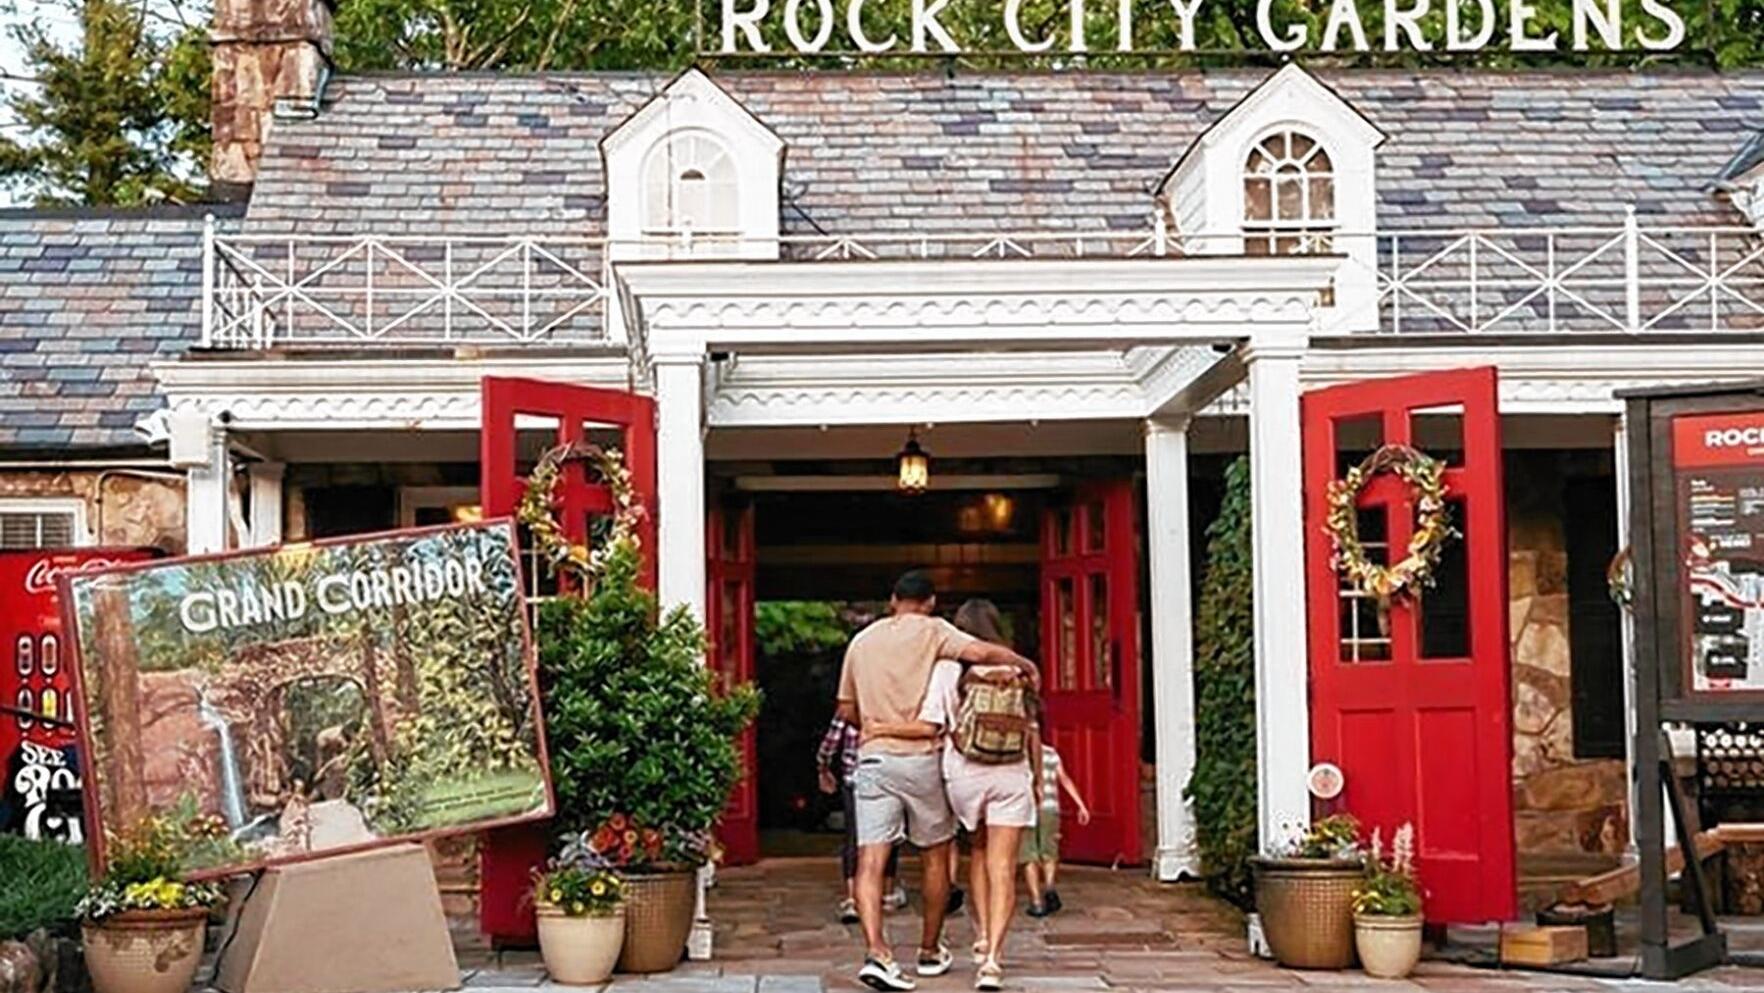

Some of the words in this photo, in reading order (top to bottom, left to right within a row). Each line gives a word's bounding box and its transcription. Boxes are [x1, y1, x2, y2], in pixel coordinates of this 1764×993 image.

[720, 0, 960, 53] ROCK
[1256, 0, 1687, 52] GARDENS
[1705, 427, 1764, 447] ROC
[180, 580, 305, 632] GRAND
[317, 558, 486, 614] CORRIDOR
[21, 740, 67, 767] SEE
